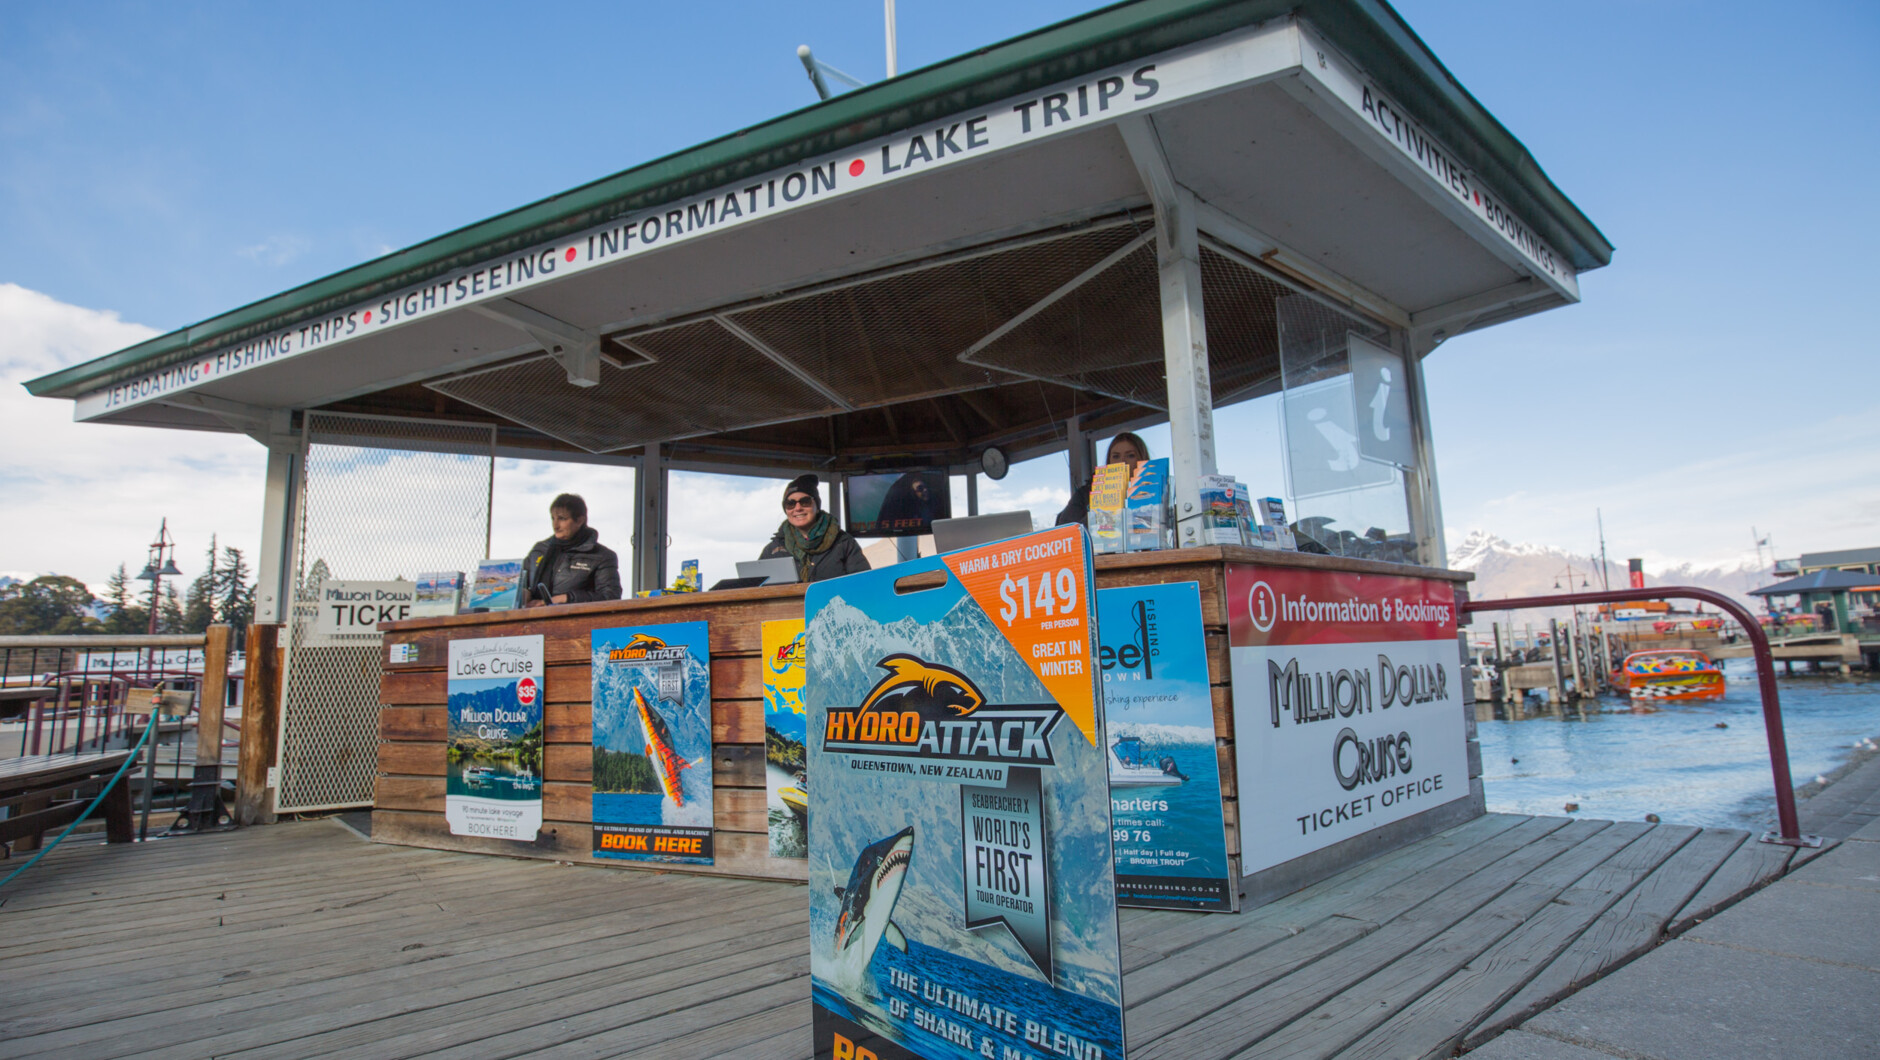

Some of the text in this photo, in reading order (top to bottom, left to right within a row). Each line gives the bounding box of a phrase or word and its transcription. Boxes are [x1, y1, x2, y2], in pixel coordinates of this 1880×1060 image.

[1362, 85, 1556, 275] ACTIVITIES BOOKINGS
[106, 64, 1160, 408] JETBOATING FISHING TRIPS SIGHTSEEING INFORMATION LAKE TRIPS
[894, 518, 923, 528] FEET
[959, 537, 1073, 575] WARM & DRY COCKPIT
[999, 568, 1077, 627] $149
[1281, 593, 1450, 627] Information & Bookings
[1041, 618, 1079, 630] PER PERSON
[1146, 599, 1160, 656] FISHING
[1032, 640, 1082, 658] GREAT IN
[457, 658, 533, 675] Lake Cruise
[1040, 660, 1083, 677] WINTER
[517, 685, 536, 698] $35
[1133, 693, 1179, 710] experience
[851, 759, 1002, 781] QUEENSTOWN, NEW ZEALAND
[972, 793, 1030, 814] SEABREACHER X
[1297, 774, 1443, 835] TICKET OFFICE
[468, 823, 491, 834] BOOK
[972, 815, 1030, 850] WORLD'S
[1118, 818, 1143, 826] times
[1145, 818, 1165, 827] call:
[600, 833, 703, 854] BOOK HERE
[1132, 830, 1151, 842] 76
[1130, 857, 1158, 865] BROWN
[1140, 849, 1154, 857] day
[1160, 849, 1174, 857] Full
[1175, 850, 1190, 859] day
[975, 846, 1032, 897] FIRST
[975, 890, 1034, 914] TOUR OPERATOR
[889, 966, 1102, 1060] THE ULTIMATE BLEND
[889, 996, 909, 1019] OF
[913, 1007, 974, 1050] SHARK
[980, 1036, 995, 1060] &
